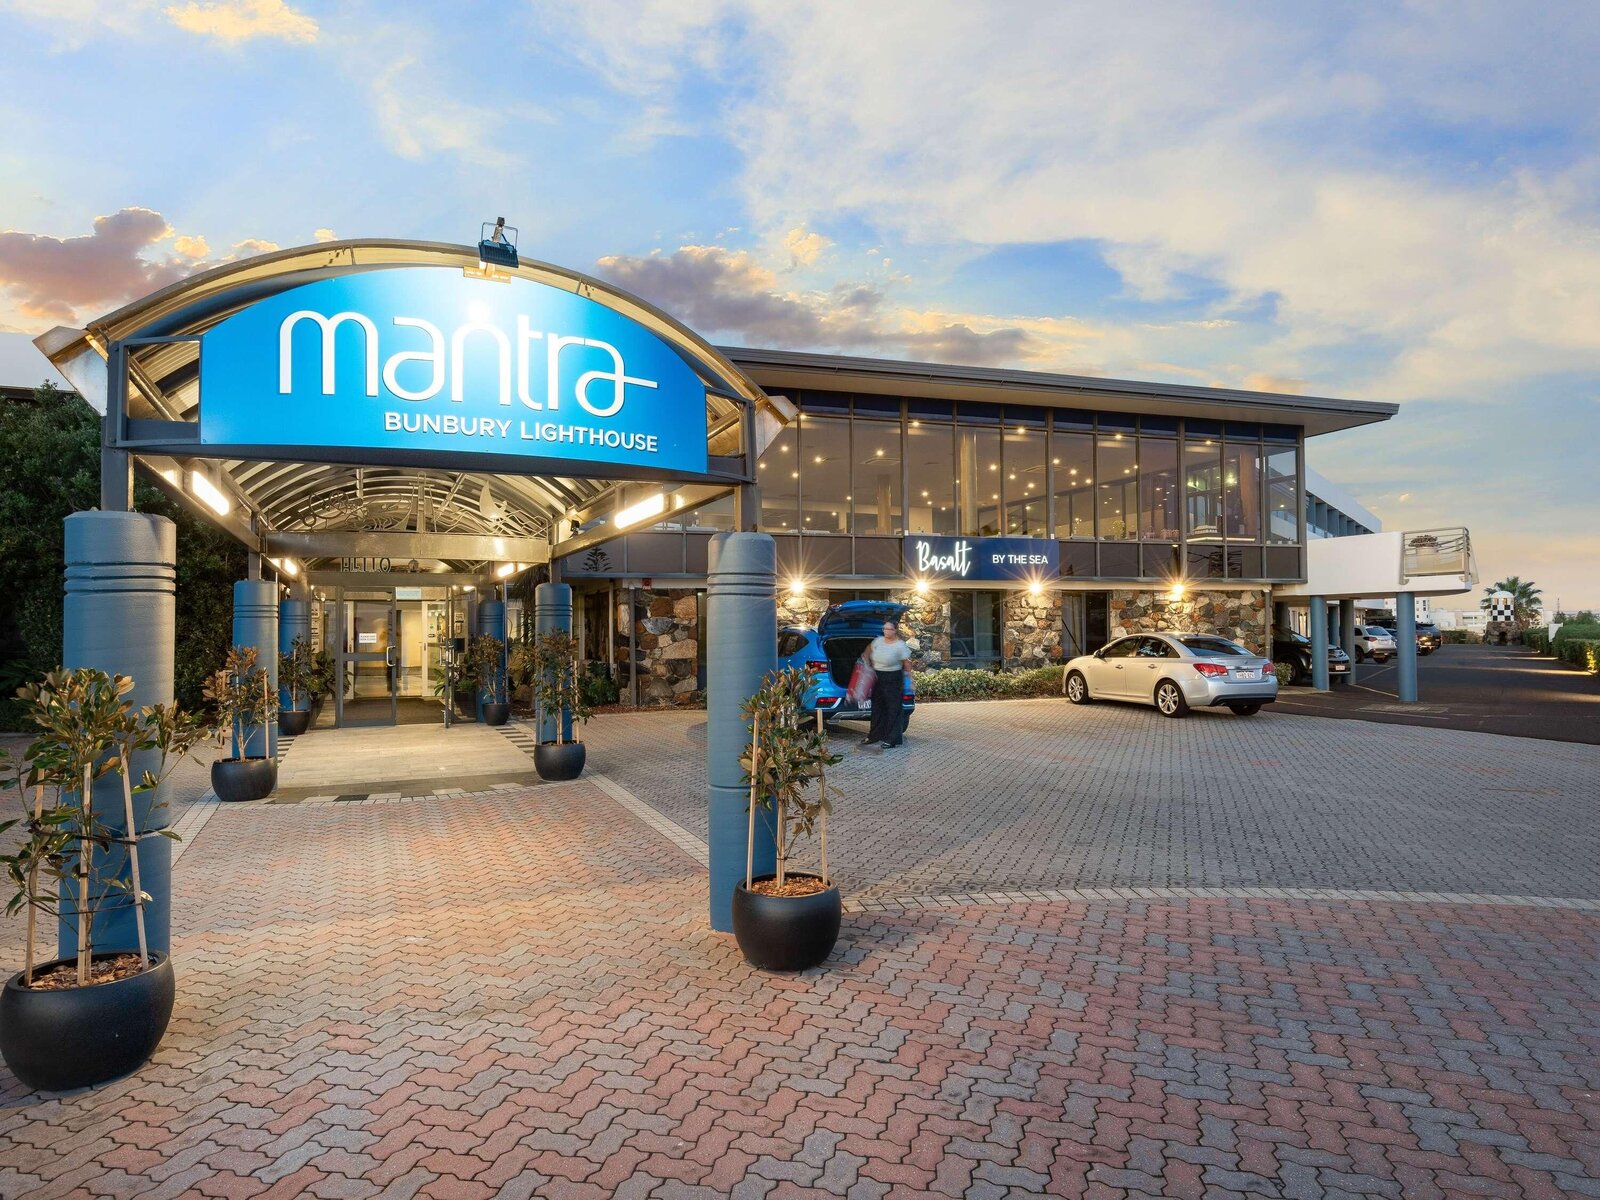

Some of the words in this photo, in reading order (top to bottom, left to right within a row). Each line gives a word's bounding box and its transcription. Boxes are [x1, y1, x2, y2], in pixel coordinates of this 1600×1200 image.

[279, 310, 658, 417] mantra
[384, 411, 513, 438] BUNBURY
[520, 420, 659, 452] LIGHTHOUSE
[915, 540, 973, 577] Basalt
[992, 554, 1006, 564] BY
[1007, 554, 1027, 564] THE
[1029, 555, 1049, 564] SEA
